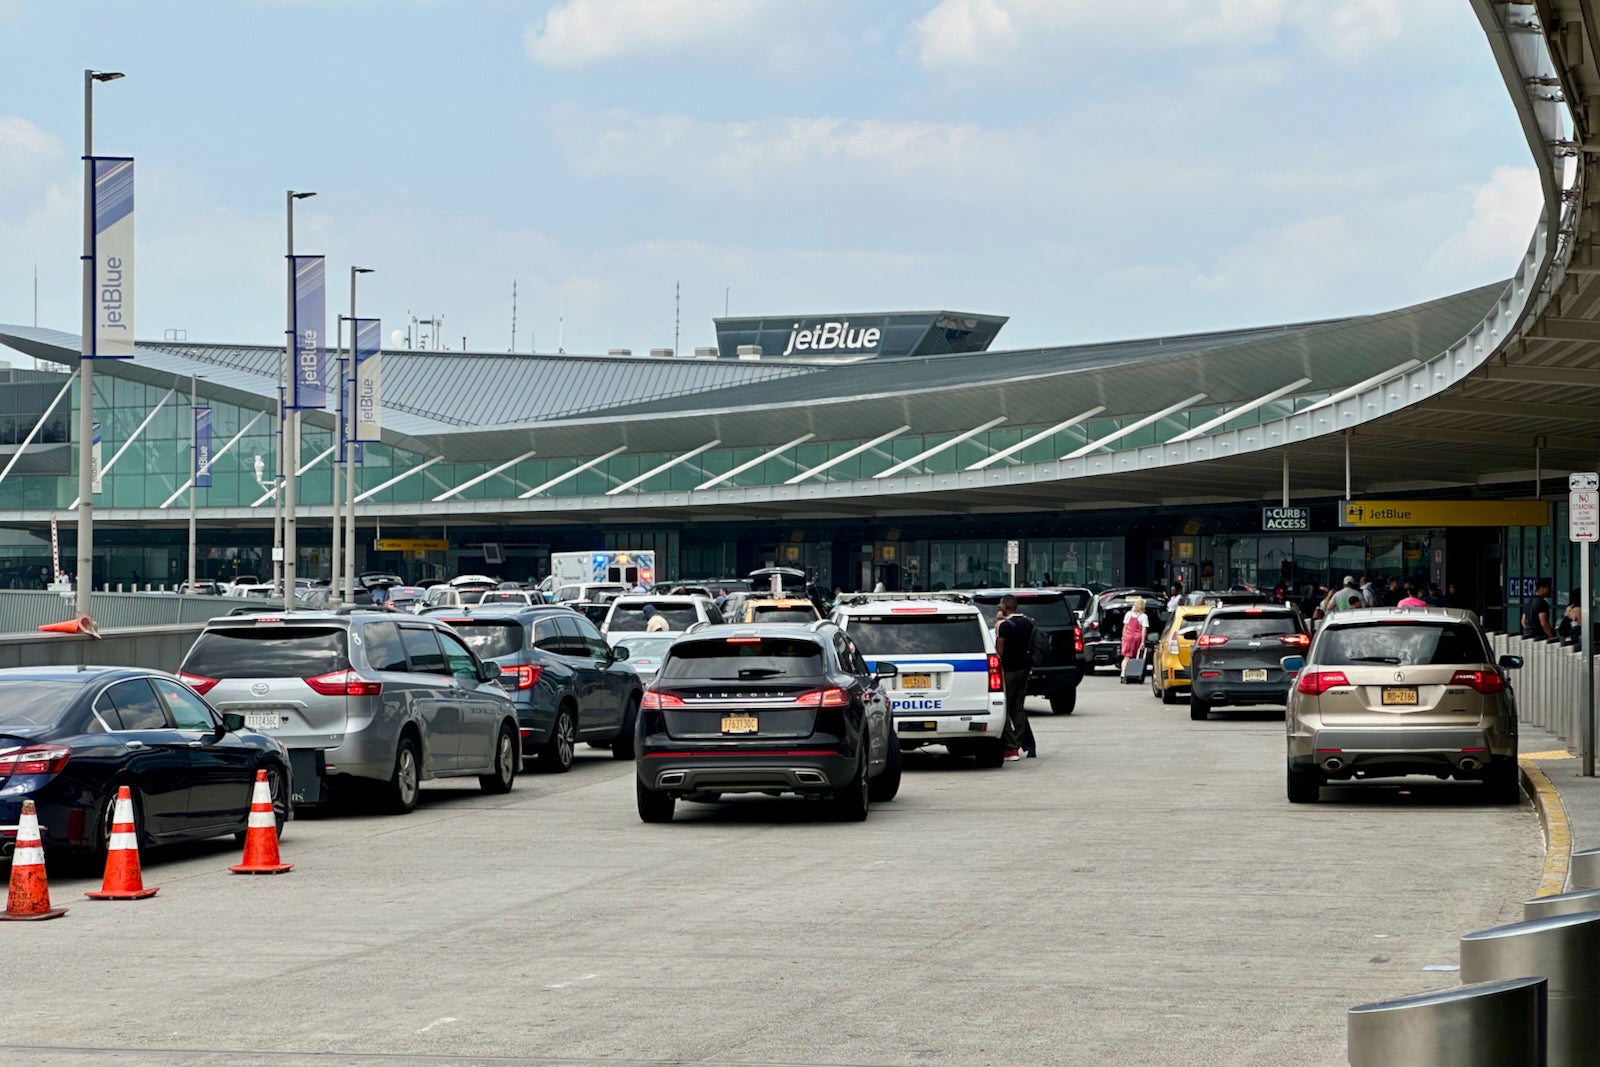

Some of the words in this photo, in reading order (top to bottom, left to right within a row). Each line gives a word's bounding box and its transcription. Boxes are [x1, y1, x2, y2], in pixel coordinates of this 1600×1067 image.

[101, 256, 127, 330] jetBlue
[782, 322, 881, 357] jetBlue
[301, 330, 320, 386] jetBlue
[360, 378, 376, 424] jetBlue
[1579, 493, 1590, 503] NO
[1272, 508, 1301, 519] CURB
[1369, 508, 1411, 519] JetBlue
[1266, 519, 1307, 529] ACCESS
[892, 700, 942, 710] POLICE
